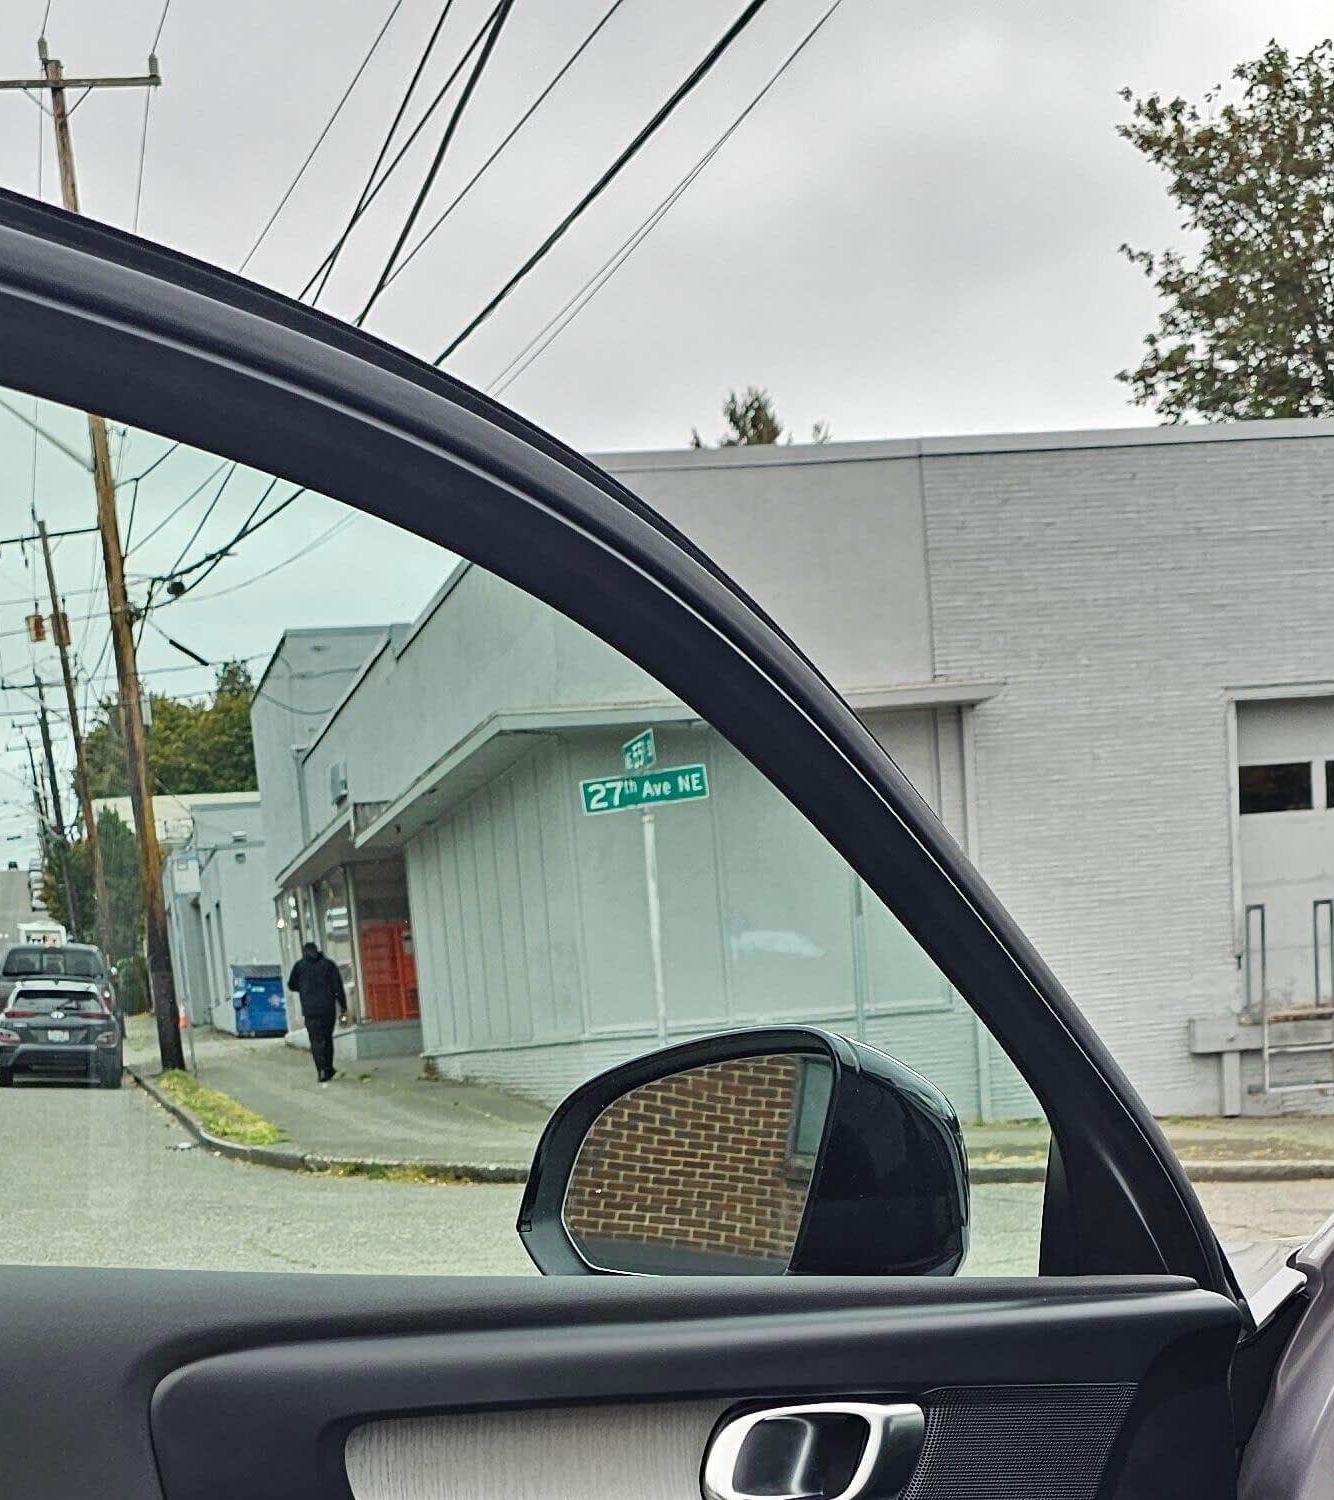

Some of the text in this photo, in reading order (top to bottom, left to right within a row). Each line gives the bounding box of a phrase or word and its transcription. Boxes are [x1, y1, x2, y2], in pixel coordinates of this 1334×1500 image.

[588, 773, 704, 810] 27th Ave NE
